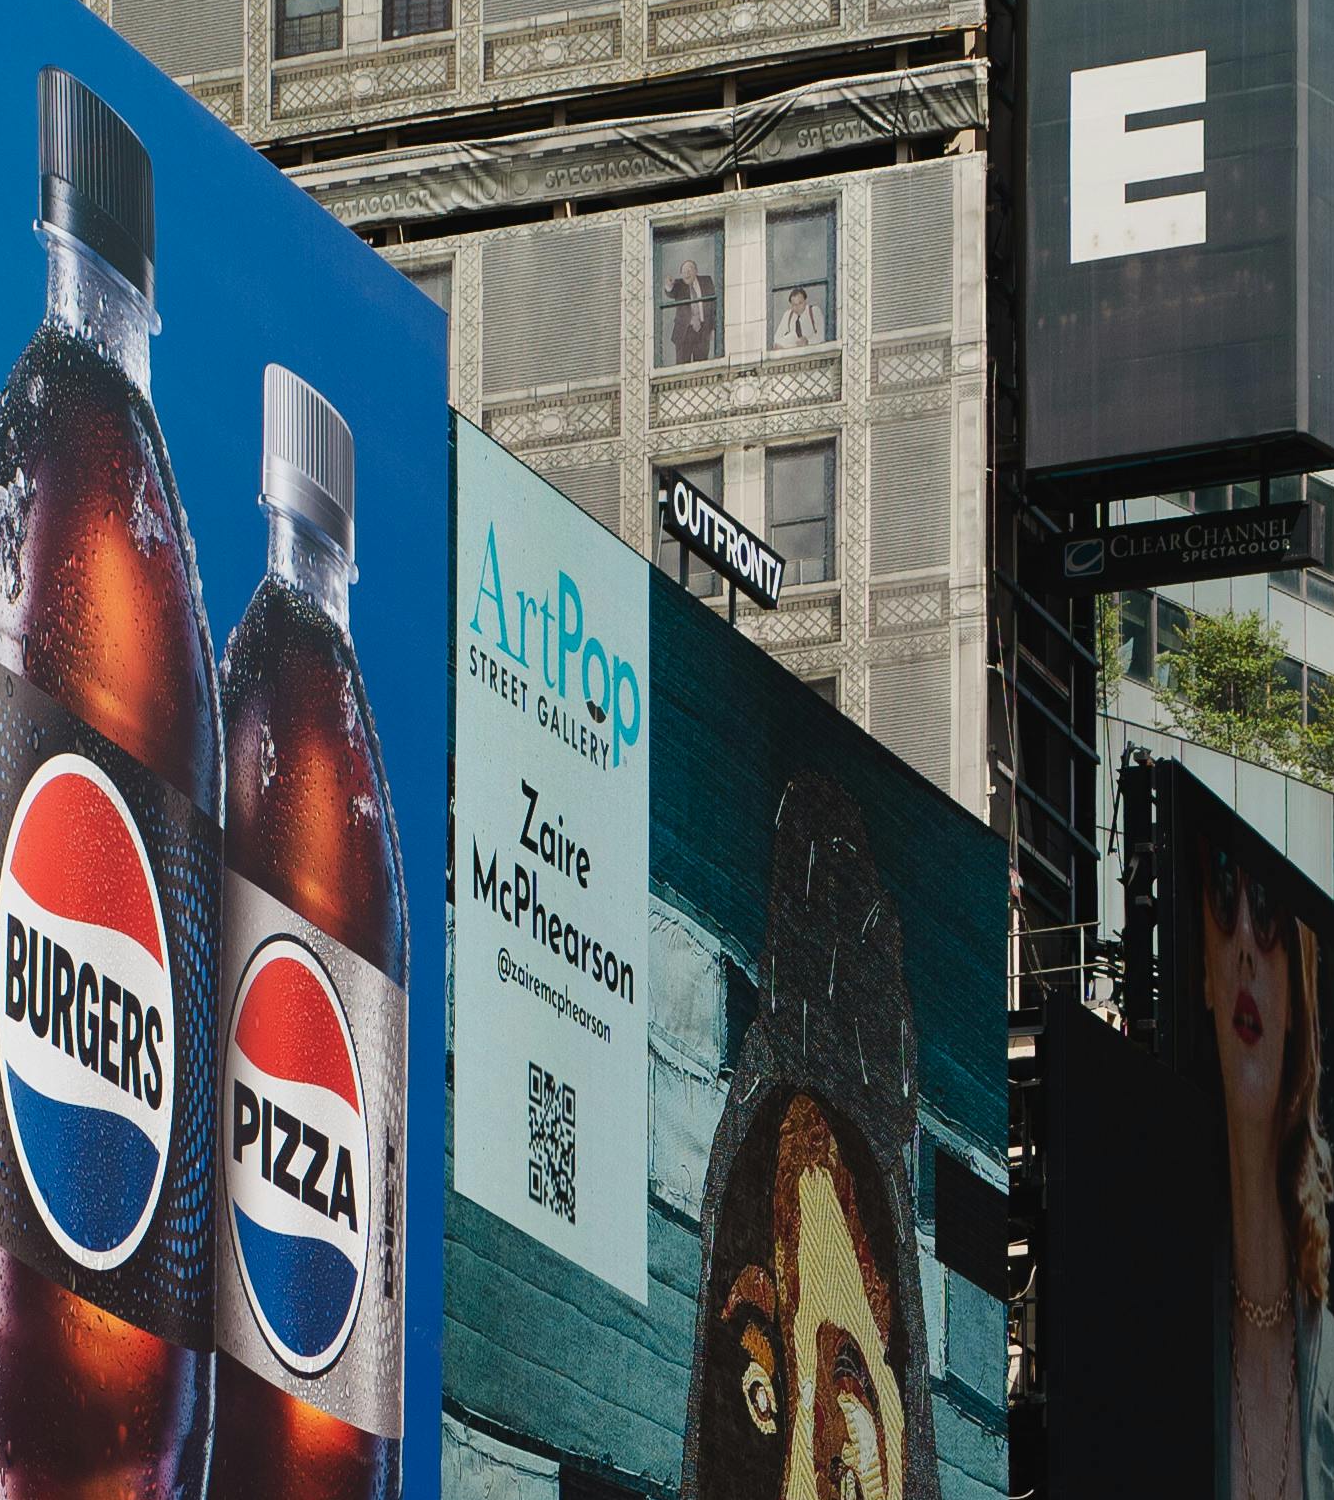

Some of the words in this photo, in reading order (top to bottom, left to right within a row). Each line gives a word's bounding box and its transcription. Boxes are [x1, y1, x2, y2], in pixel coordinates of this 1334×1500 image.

[545, 155, 675, 189] SPECTACOL
[1182, 538, 1290, 563] SPECTACOLOR
[469, 521, 641, 769] ArtPop
[469, 644, 528, 714] STREET
[537, 695, 610, 772] GALLERY
[519, 778, 591, 889] Zaire
[473, 832, 635, 1005] McPhearson
[5, 912, 164, 1111] BURGERS
[497, 947, 611, 1044] @zairemcphearson
[233, 1077, 358, 1234] PIZZA
